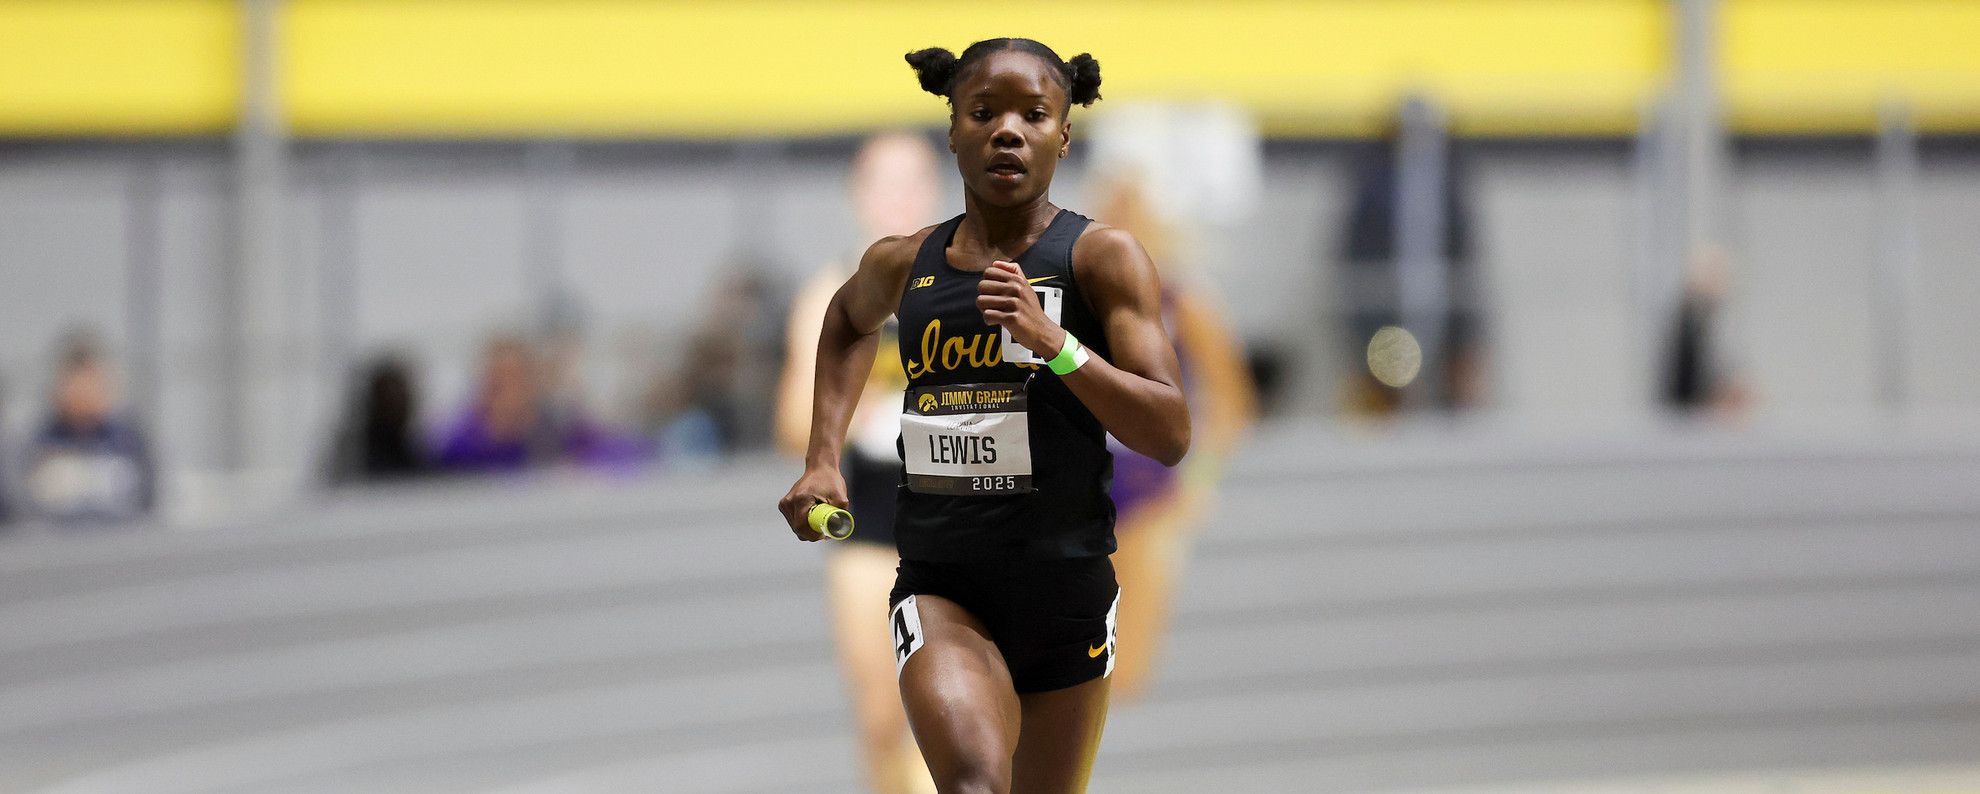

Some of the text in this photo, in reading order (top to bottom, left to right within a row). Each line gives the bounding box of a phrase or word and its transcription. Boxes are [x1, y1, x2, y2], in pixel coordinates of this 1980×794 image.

[907, 319, 1040, 379] Iow
[941, 390, 1012, 406] JIMMY GRANT
[951, 403, 1000, 411] INVITATIONAL
[929, 435, 997, 464] LEWIS
[972, 476, 1015, 490] 2025
[894, 607, 916, 660] 4
